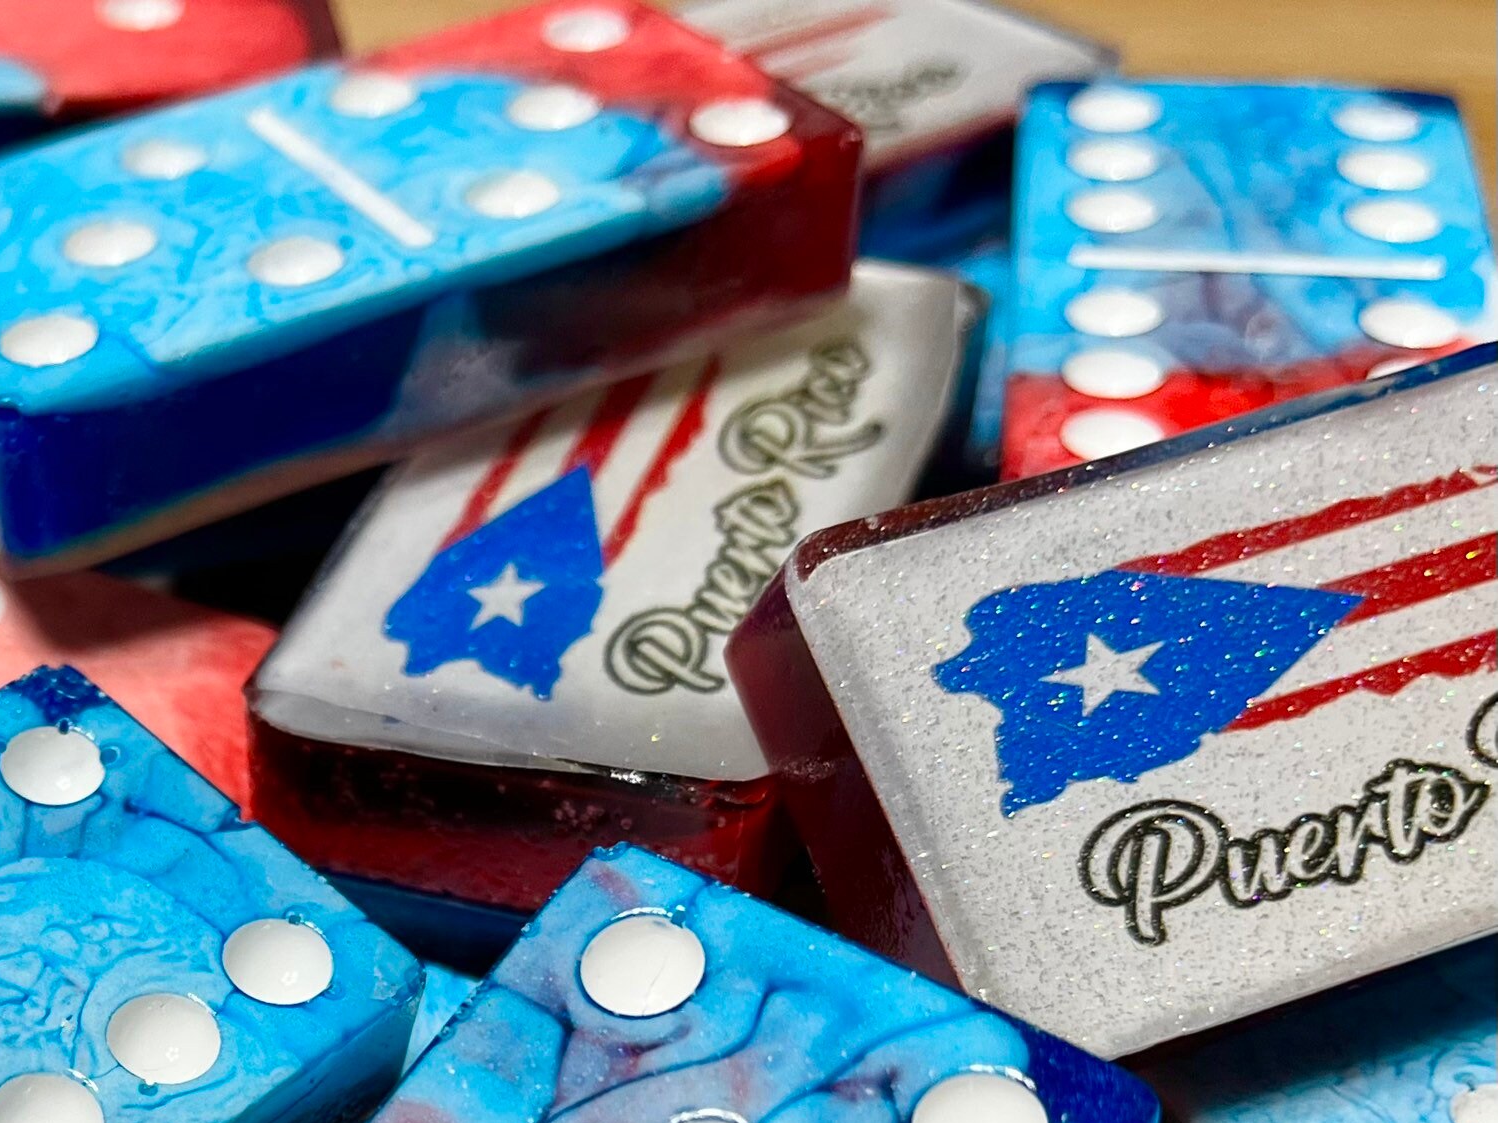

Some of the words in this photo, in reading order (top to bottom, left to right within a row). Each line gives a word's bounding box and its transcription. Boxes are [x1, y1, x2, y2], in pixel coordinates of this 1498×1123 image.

[605, 477, 800, 696] Puerto
[718, 340, 885, 480] Rico
[1077, 759, 1490, 947] Puerto
